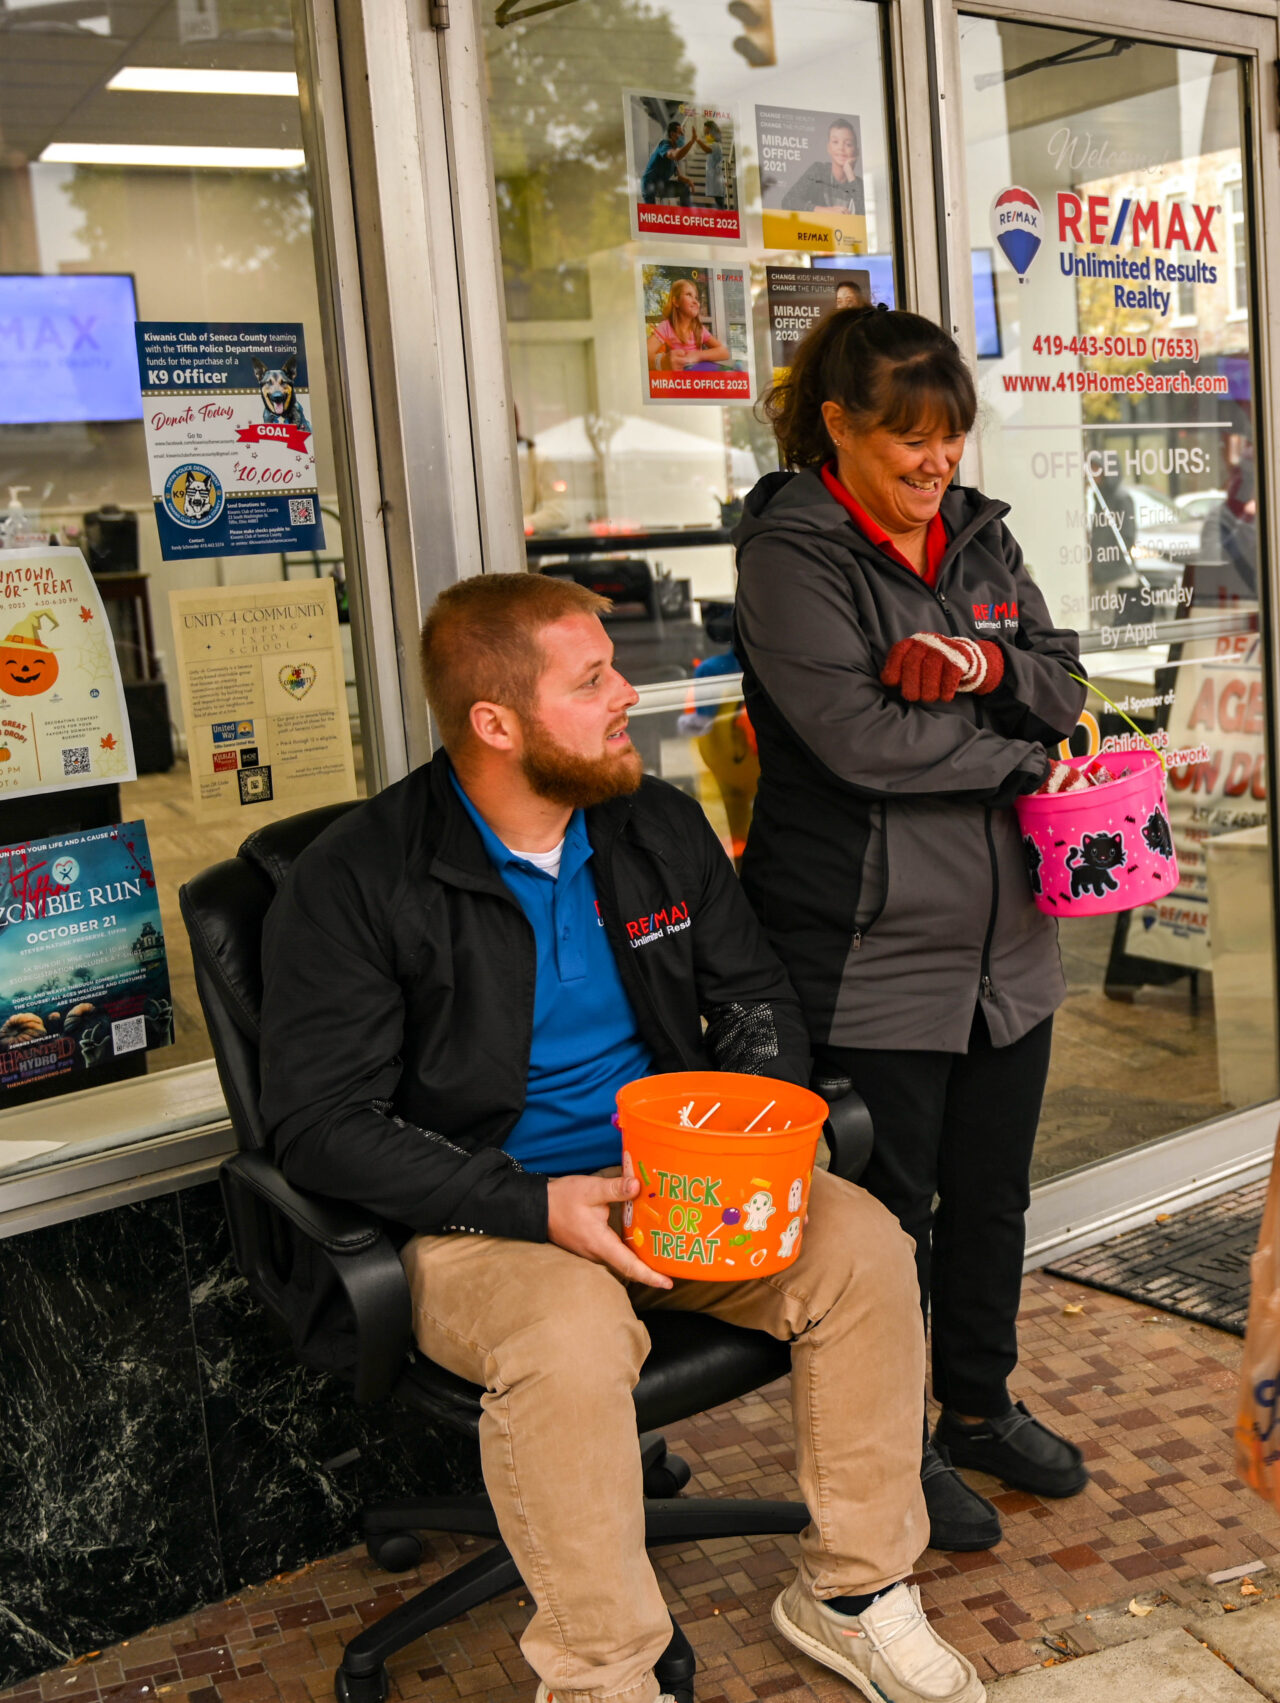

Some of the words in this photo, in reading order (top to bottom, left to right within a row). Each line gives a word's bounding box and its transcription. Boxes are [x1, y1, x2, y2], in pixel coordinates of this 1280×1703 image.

[704, 110, 730, 119] RE/MAX
[762, 134, 808, 148] MIRACLE
[763, 148, 800, 160] OFFICE
[764, 161, 786, 172] 2021
[640, 212, 680, 225] MIRACLE
[682, 216, 714, 228] OFFICE
[716, 218, 738, 230] 2022
[1000, 210, 1037, 228] RE/MAX
[1057, 192, 1218, 252] RE/MAX
[798, 232, 828, 242] RE/MAX
[1060, 252, 1150, 280] Unlimited
[1155, 258, 1217, 283] Results
[717, 274, 743, 282] RE/MAX
[1114, 285, 1170, 316] Realty
[774, 306, 820, 318] MIRACLE
[775, 318, 812, 329] OFFICE
[144, 332, 176, 342] Kiwanis
[178, 332, 196, 342] Club
[200, 333, 208, 342] of
[210, 333, 238, 342] Seneca
[240, 333, 267, 343] County
[269, 334, 296, 343] teaming
[776, 330, 799, 341] 2020
[145, 345, 162, 353] with
[163, 345, 174, 353] the
[176, 344, 198, 352] Tiffin
[200, 344, 223, 352] Police
[225, 345, 273, 354] Department
[274, 345, 297, 354] raising
[1032, 335, 1147, 357] 419-443-SOLD
[1152, 338, 1200, 362] (7653)
[146, 356, 166, 366] funds
[168, 357, 178, 366] for
[180, 357, 192, 366] the
[194, 358, 224, 367] purchase
[225, 357, 232, 365] of
[148, 370, 168, 384] K9
[173, 369, 228, 384] Officer
[652, 379, 691, 389] MIRACLE
[694, 380, 724, 389] OFFICE
[727, 380, 748, 390] 2023
[1002, 372, 1229, 393] www.419HomeSearch.com
[152, 406, 195, 430] Donate
[198, 402, 234, 422] Today
[257, 426, 290, 438] GOAL
[234, 461, 294, 484] $10,000
[1031, 450, 1118, 479] OFFICE
[1125, 448, 1211, 476] HOURS:
[173, 490, 184, 498] K9
[1066, 508, 1125, 530] Monday
[1060, 544, 1092, 564] 9:00
[1097, 546, 1120, 562] am
[34, 579, 72, 595] TREAT
[1060, 590, 1126, 614] Saturday
[1140, 586, 1194, 608] Sunday
[184, 613, 224, 628] UNITY
[229, 612, 236, 624] 4
[242, 602, 326, 623] COMMUNITY
[220, 623, 299, 638] STEPPING
[242, 634, 279, 645] INTO
[1100, 626, 1120, 646] By
[1124, 622, 1158, 643] Appt
[1130, 696, 1163, 712] Sponsor
[2, 720, 26, 731] GREAT
[212, 724, 235, 734] United
[4, 730, 28, 744] DROP!
[222, 732, 235, 740] Way
[1102, 728, 1168, 754] Children's
[1160, 744, 1210, 766] etwork
[86, 834, 108, 842] CAUSE
[0, 891, 84, 926] ZOMBIE
[88, 878, 142, 906] RUN
[1160, 906, 1208, 927] RE/MAX
[26, 920, 98, 944] OCTOBER
[102, 915, 117, 928] 21
[630, 929, 664, 948] Unlimited
[46, 941, 72, 950] NATURE
[72, 932, 106, 943] PRESERVE,
[108, 928, 126, 936] TIFFIN
[12, 994, 32, 1004] DODGE
[47, 988, 66, 996] WEAVE
[68, 980, 94, 990] THROUGH
[95, 974, 118, 984] ZOMBIES
[62, 990, 76, 999] AGES
[78, 984, 104, 996] WELCOME
[118, 974, 146, 985] COSTUMES
[19, 1054, 58, 1072] HYDRO
[657, 1171, 722, 1207] TRICK
[669, 1204, 702, 1234] OR
[650, 1230, 720, 1264] TREAT
